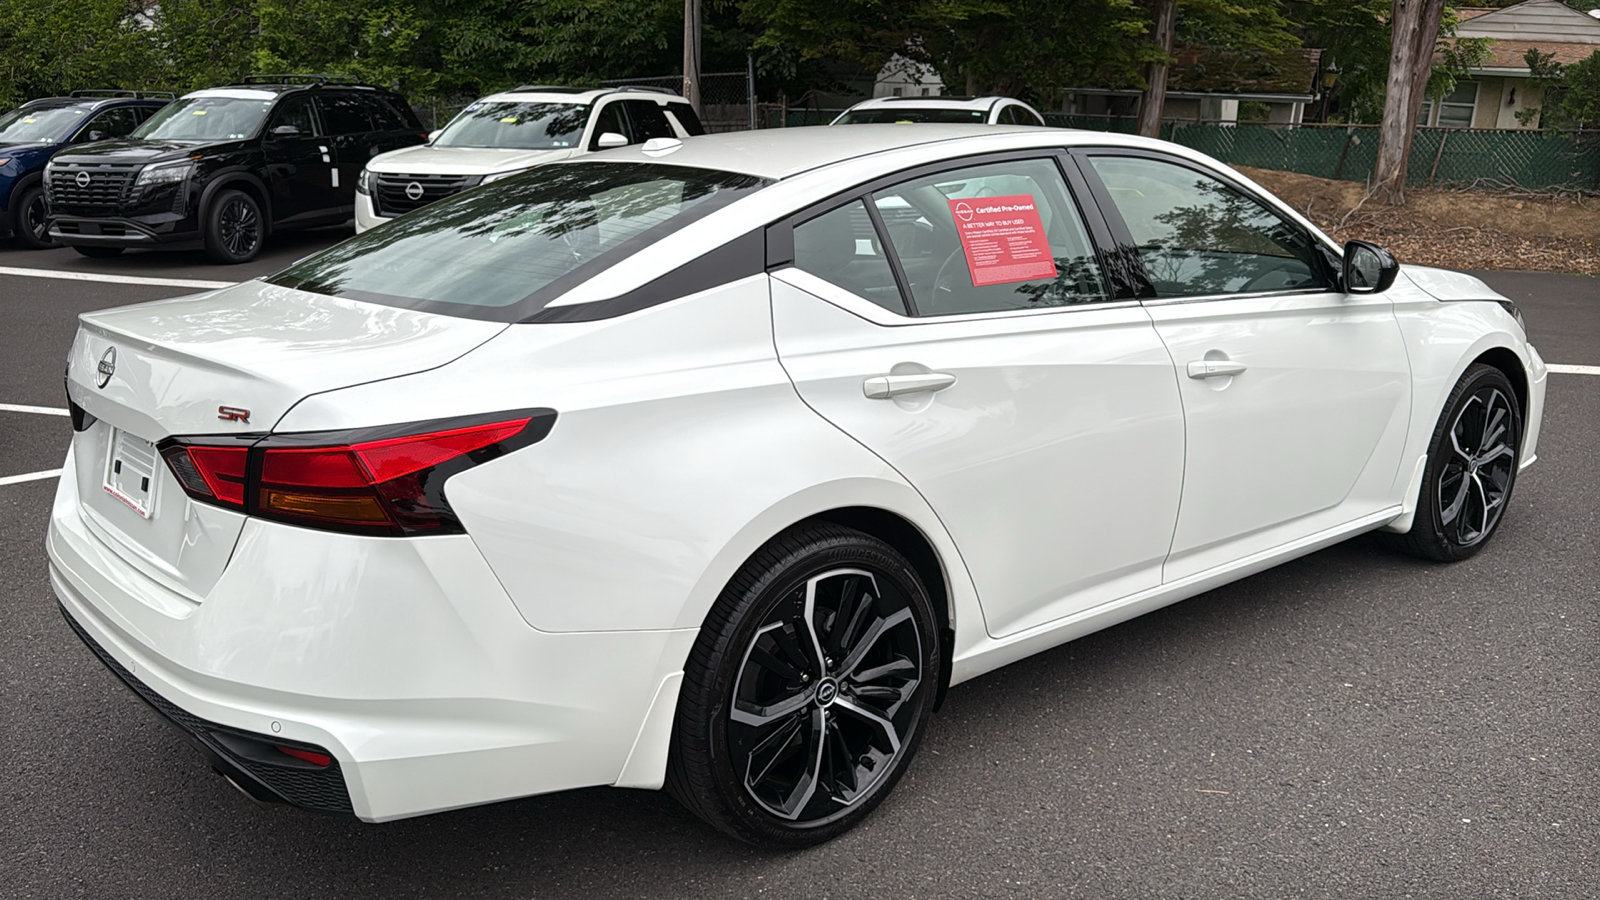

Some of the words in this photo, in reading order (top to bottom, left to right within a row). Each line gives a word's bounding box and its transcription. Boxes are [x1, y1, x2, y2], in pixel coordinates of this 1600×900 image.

[976, 206, 1001, 214] Certified
[1001, 203, 1034, 212] Pre-Owned
[217, 405, 251, 425] SR
[827, 547, 900, 572] BRIDGESTONE
